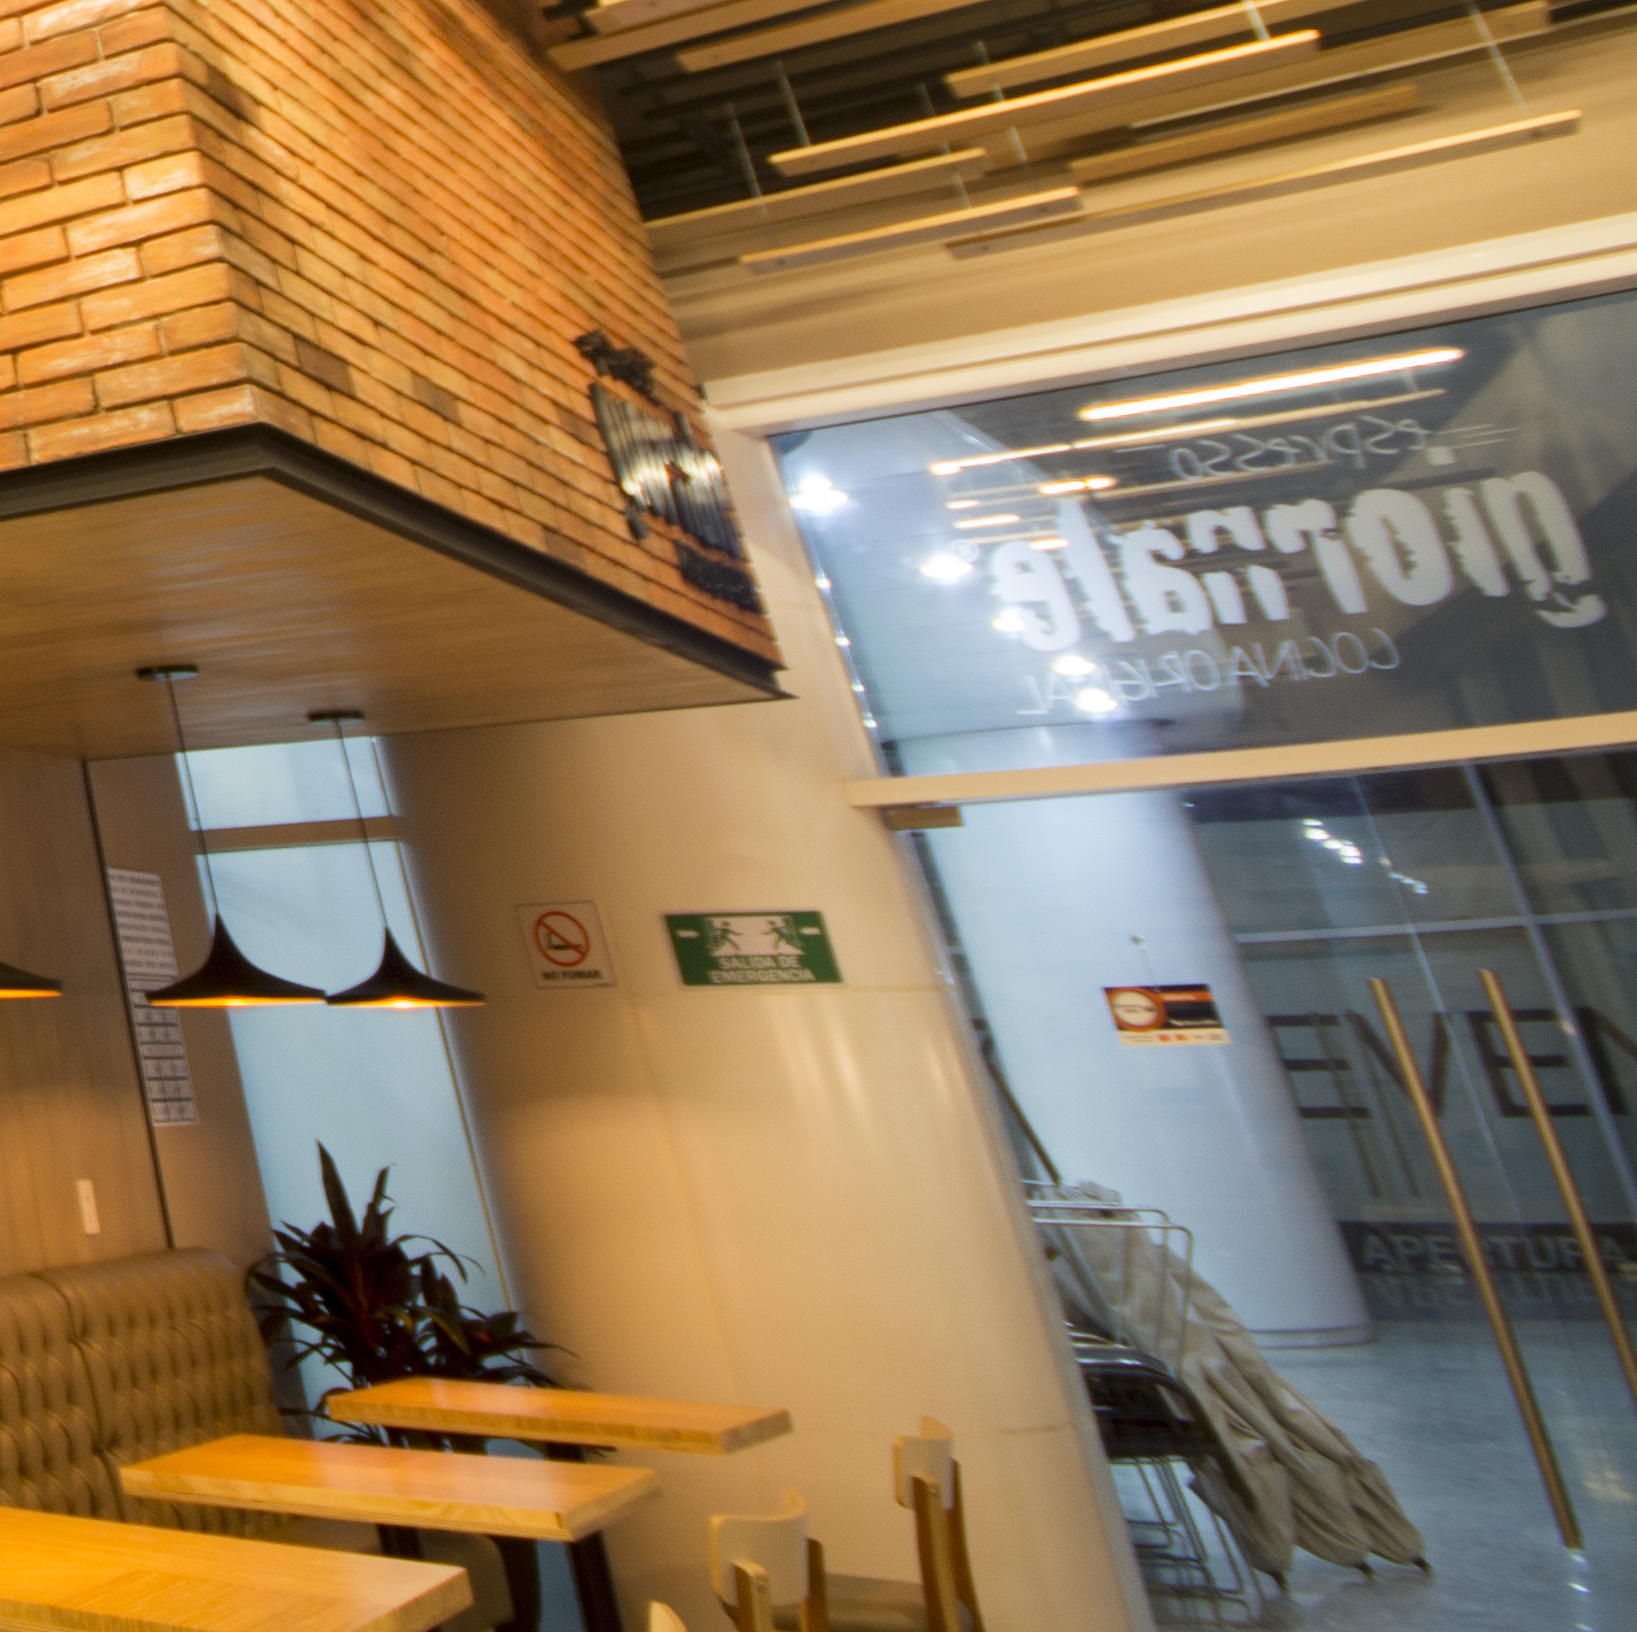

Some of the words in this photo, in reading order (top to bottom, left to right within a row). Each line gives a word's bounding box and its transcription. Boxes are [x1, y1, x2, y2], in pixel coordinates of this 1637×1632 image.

[719, 956, 775, 969] SALIDA
[778, 956, 801, 968] DE
[542, 971, 563, 981] NO
[565, 970, 603, 980] FUMAR
[710, 969, 817, 983] EMERGENCIA
